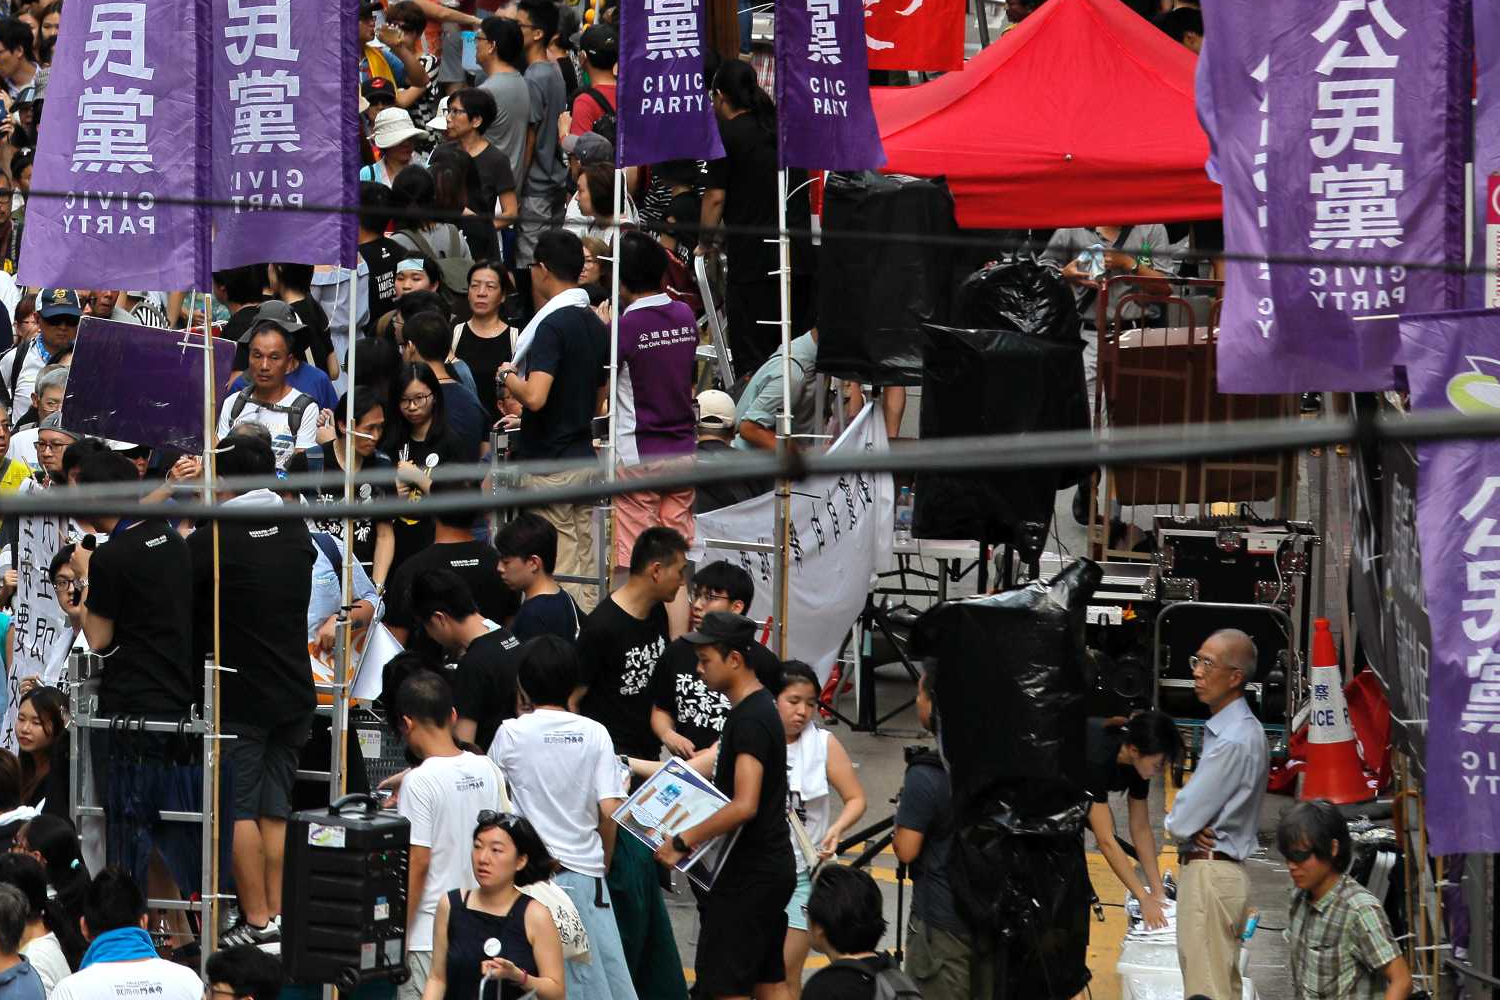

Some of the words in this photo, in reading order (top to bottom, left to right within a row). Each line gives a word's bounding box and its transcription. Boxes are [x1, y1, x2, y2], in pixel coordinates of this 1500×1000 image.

[642, 71, 704, 94] CIVIC
[640, 94, 705, 116] PARTY
[1315, 684, 1329, 701] 察
